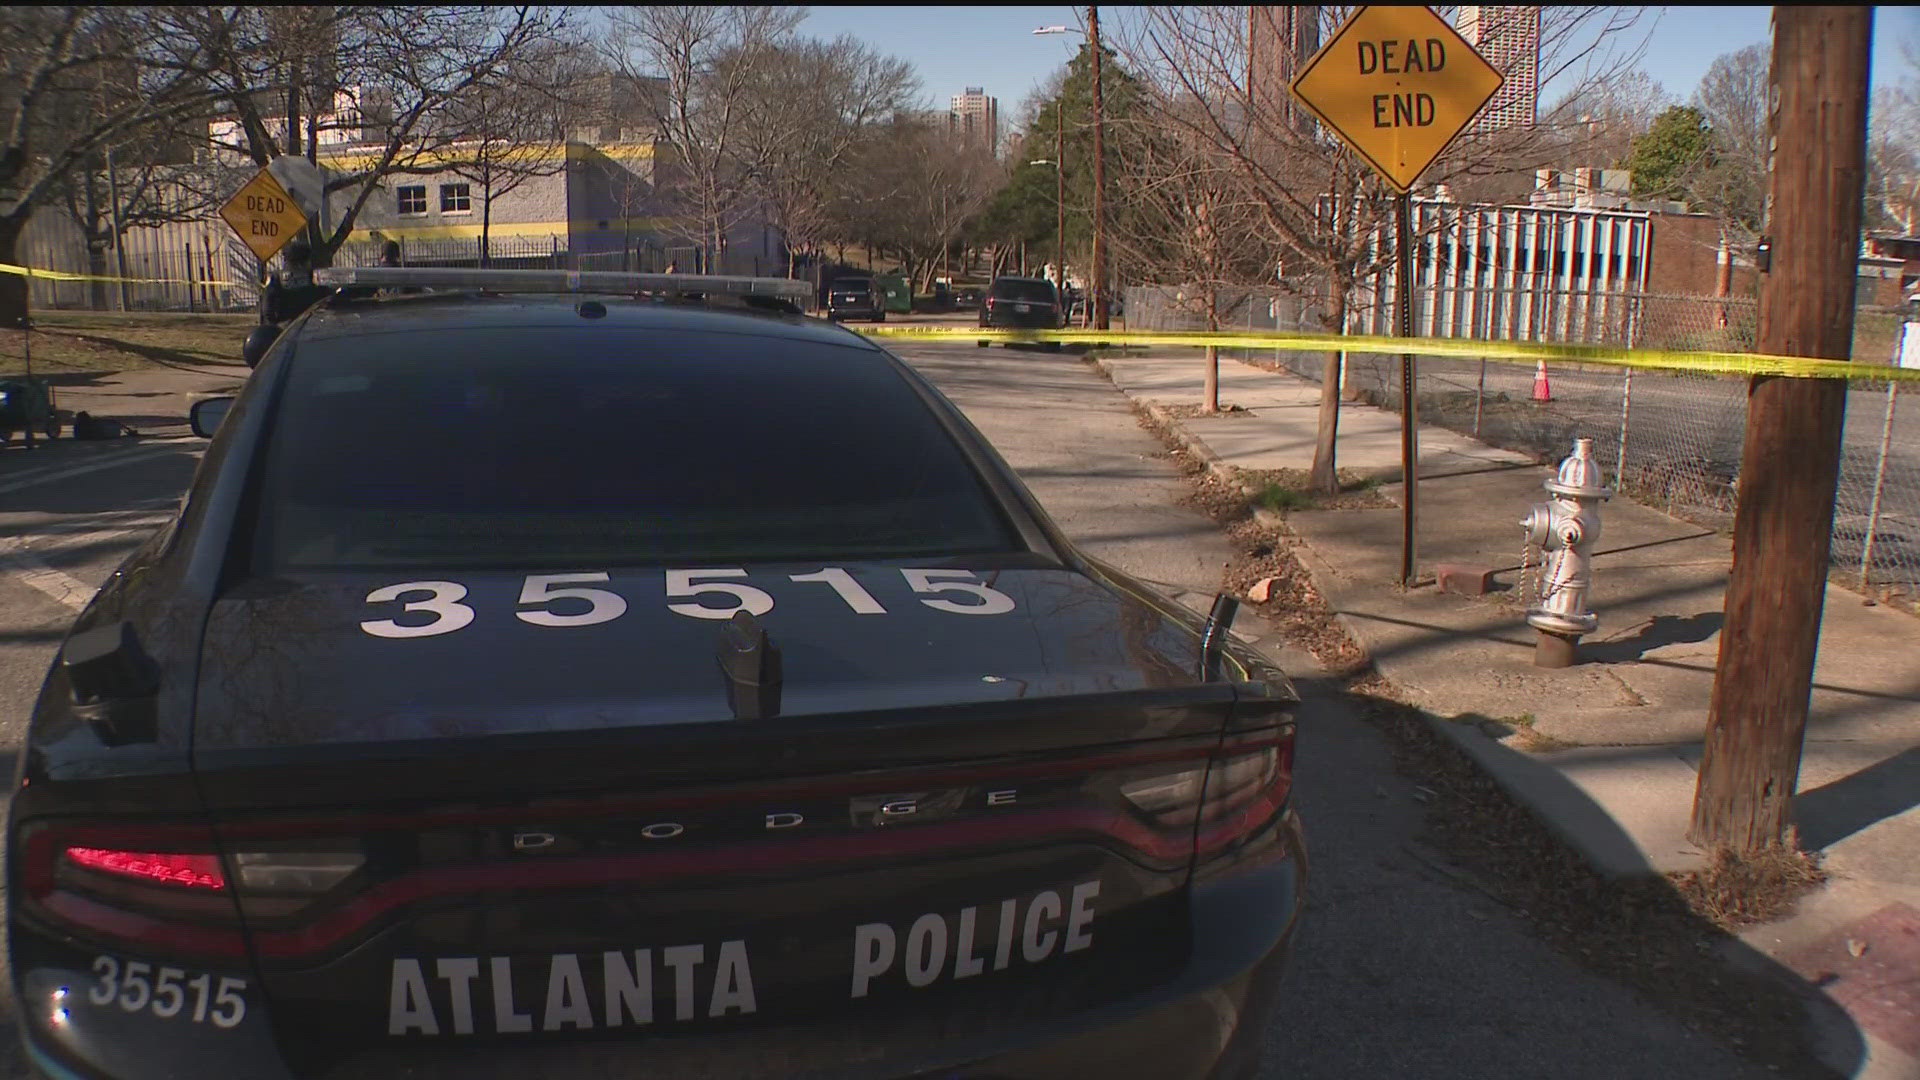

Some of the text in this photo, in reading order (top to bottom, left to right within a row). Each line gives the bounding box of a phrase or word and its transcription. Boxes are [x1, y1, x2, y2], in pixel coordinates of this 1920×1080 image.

[1357, 39, 1446, 75] DEAD
[1373, 94, 1435, 128] END
[247, 196, 285, 214] DEAD
[252, 220, 279, 237] END
[360, 567, 1016, 638] 35515
[514, 789, 1018, 849] DODGE
[388, 880, 1102, 1035] ATLANTA POLICE
[91, 956, 247, 1028] 35515
